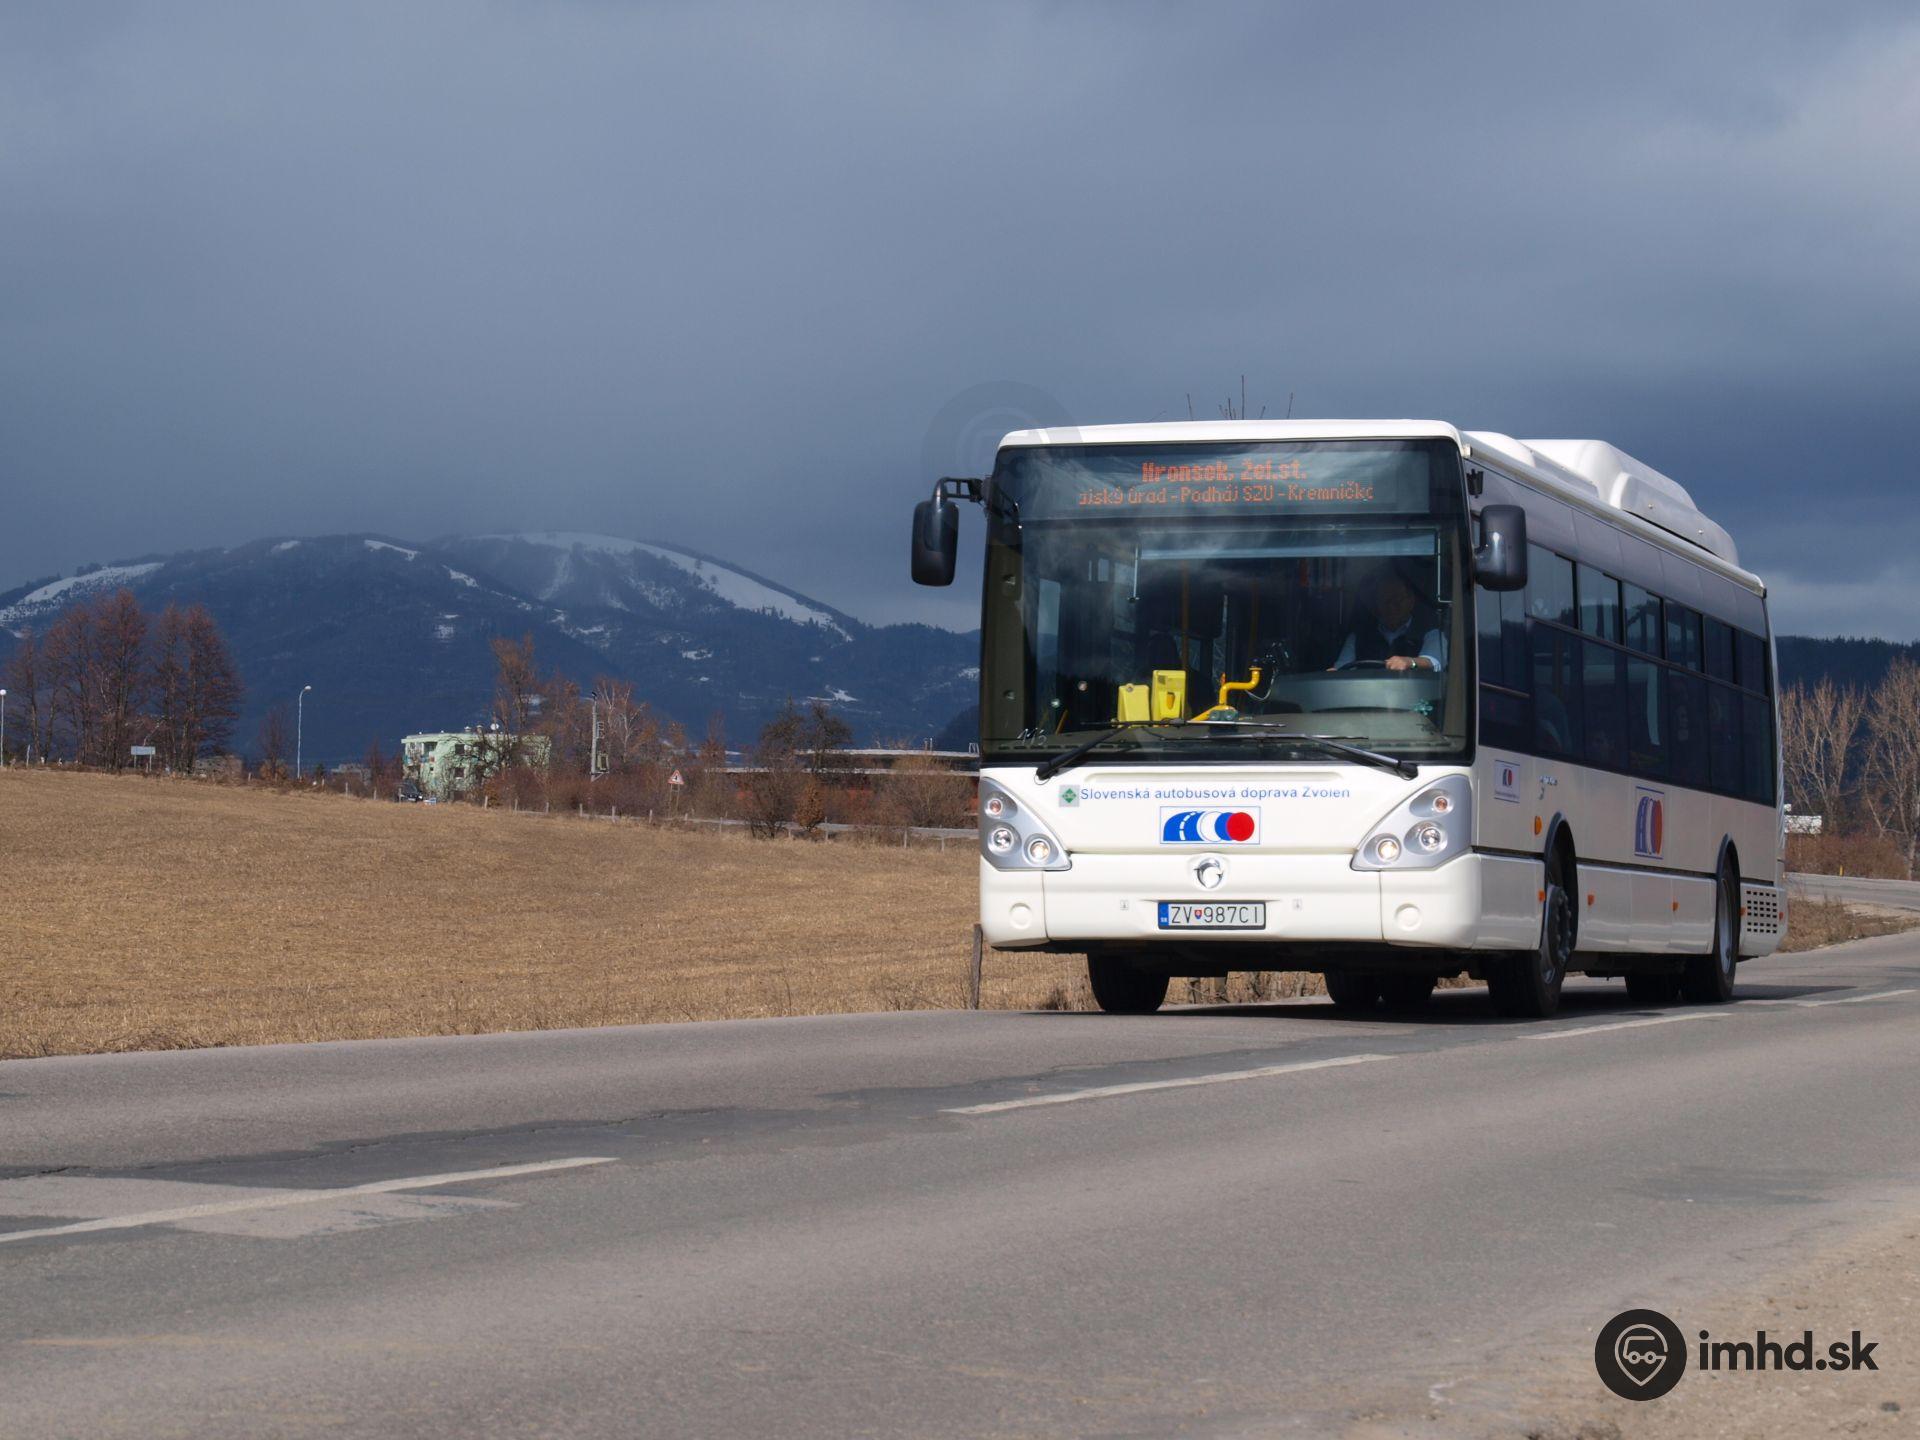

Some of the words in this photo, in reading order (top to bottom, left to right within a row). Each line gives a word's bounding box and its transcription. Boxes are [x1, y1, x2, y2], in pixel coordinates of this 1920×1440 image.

[1080, 787, 1150, 800] Slovenská
[1155, 786, 1236, 799] autobusová
[1241, 786, 1297, 801] doprava
